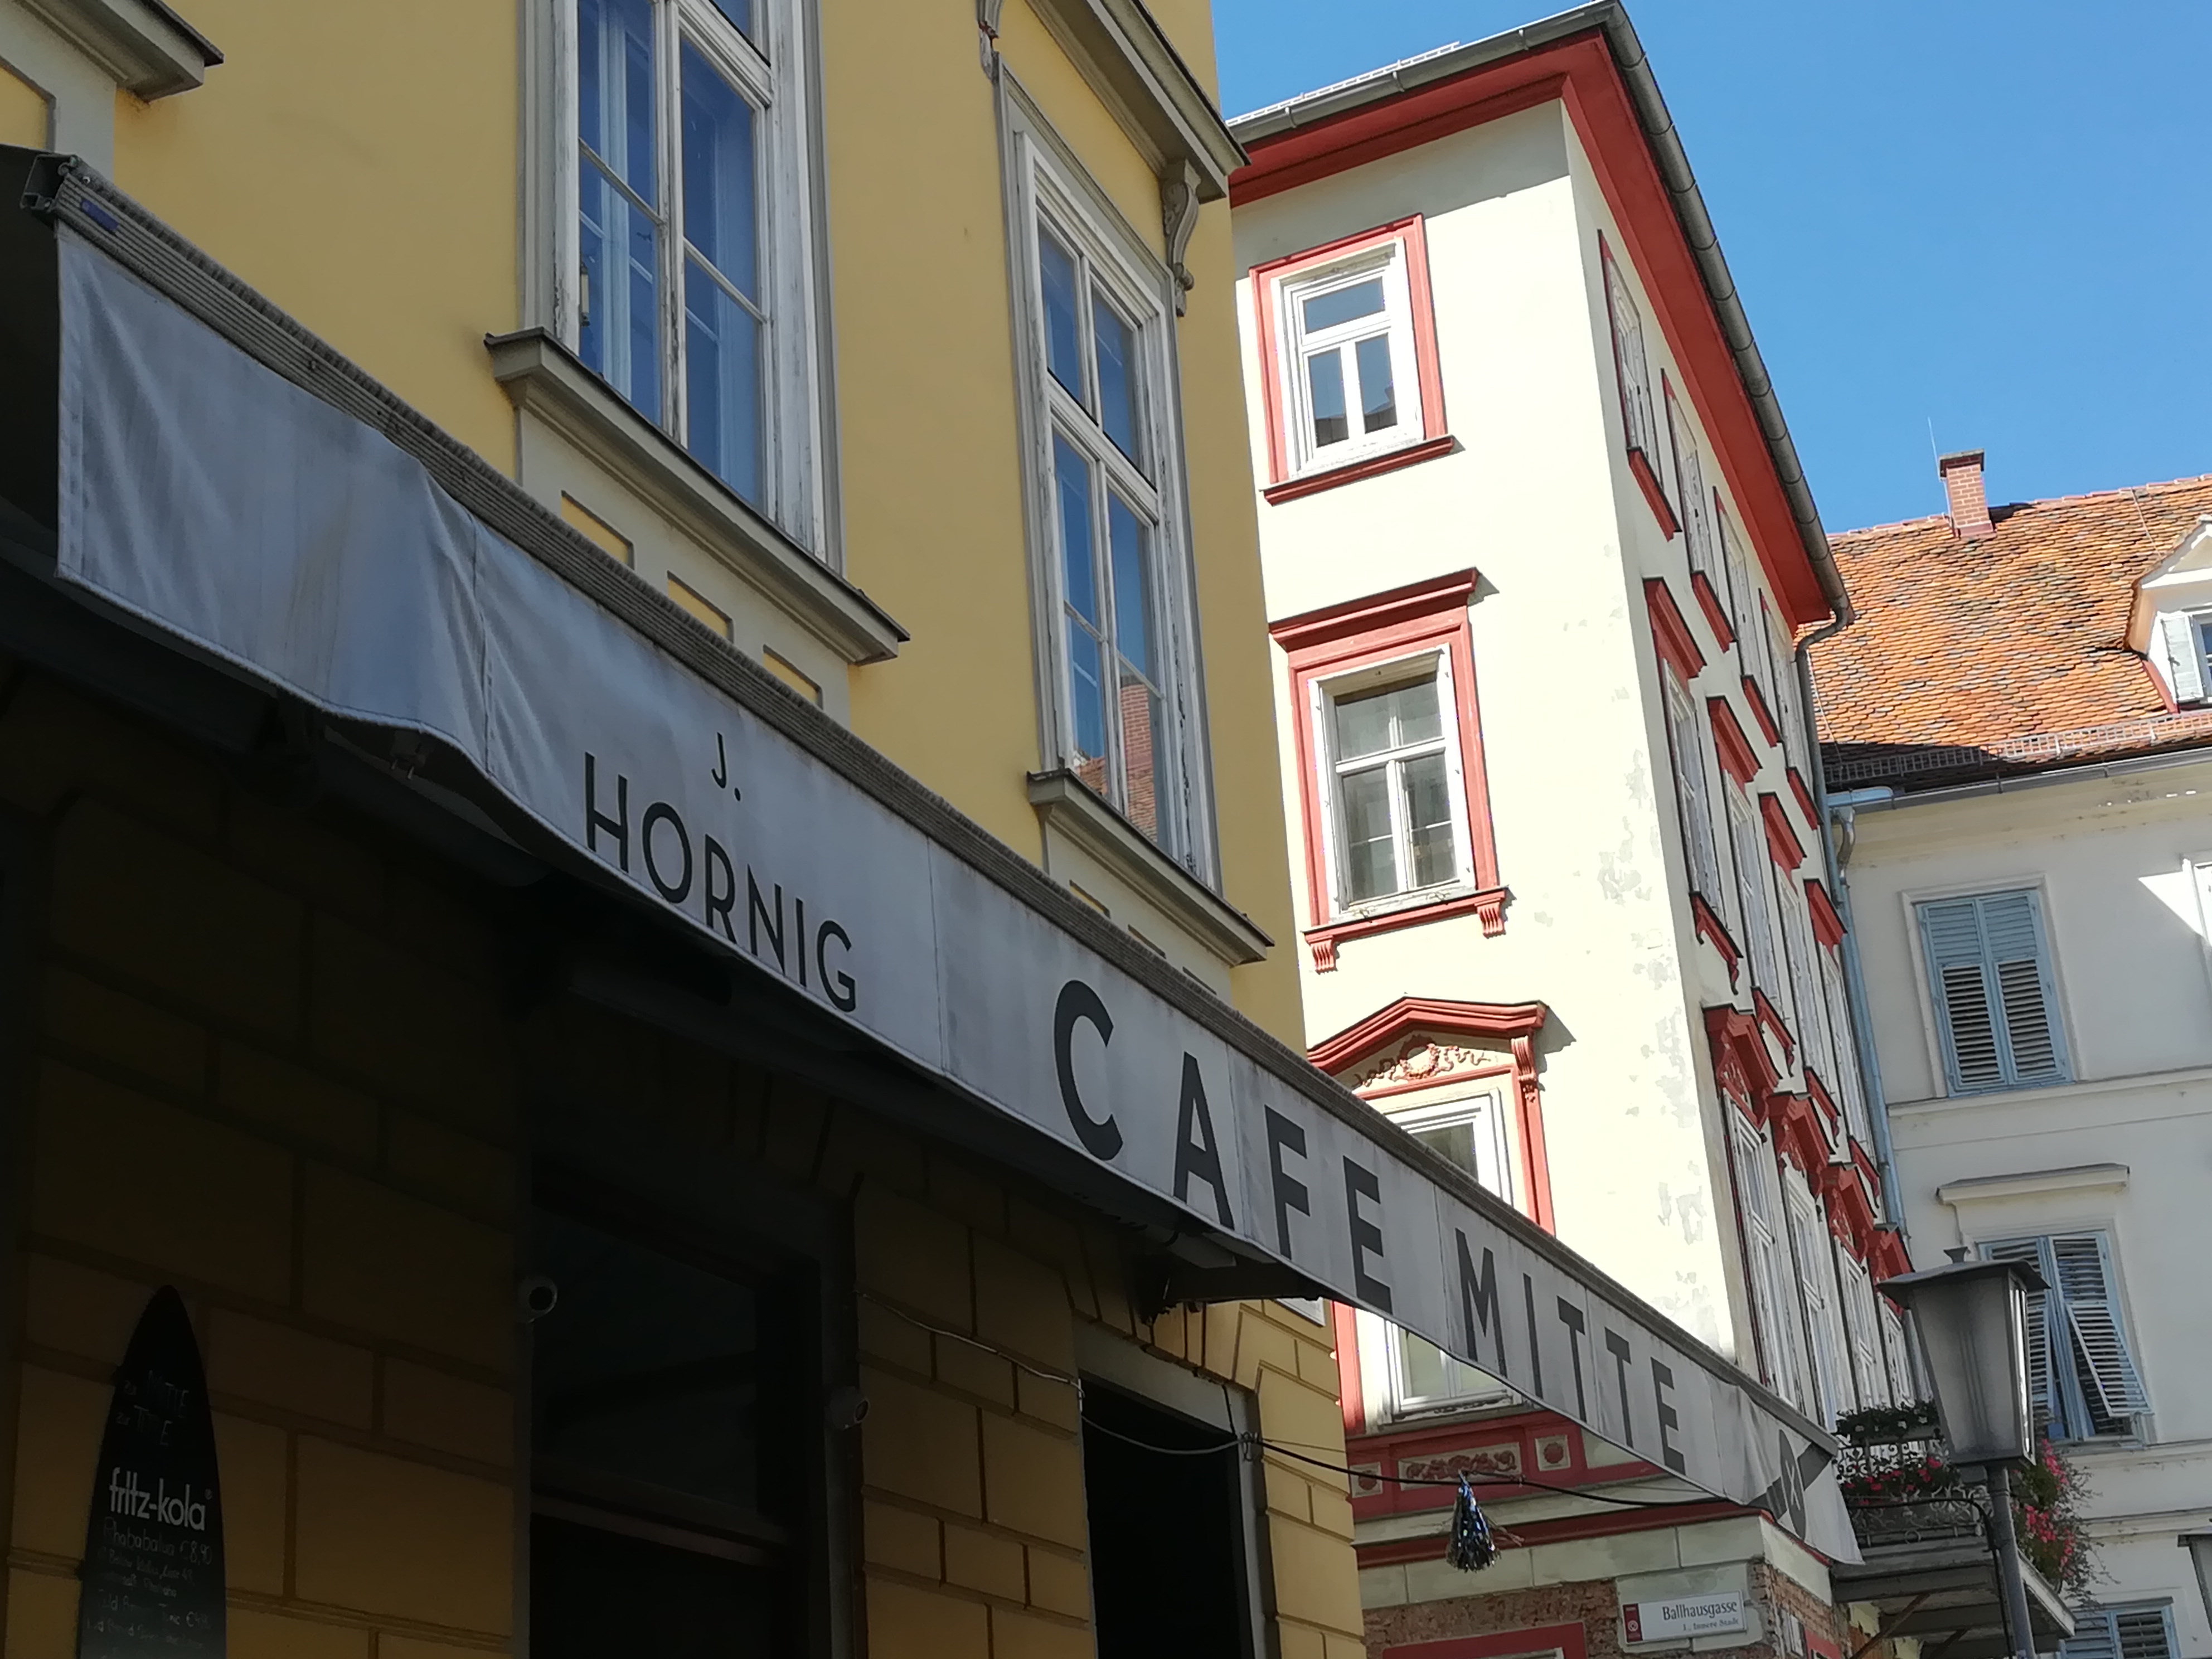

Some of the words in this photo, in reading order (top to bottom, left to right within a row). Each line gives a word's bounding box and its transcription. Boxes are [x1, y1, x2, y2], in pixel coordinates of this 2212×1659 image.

[711, 731, 741, 801] J.
[585, 751, 856, 1012] HORNIG
[1055, 979, 1393, 1314] CAFE
[1456, 1228, 1686, 1476] MITTE
[108, 1466, 206, 1531] fritz-kola
[1662, 1600, 1738, 1621] Ballhausgasse
